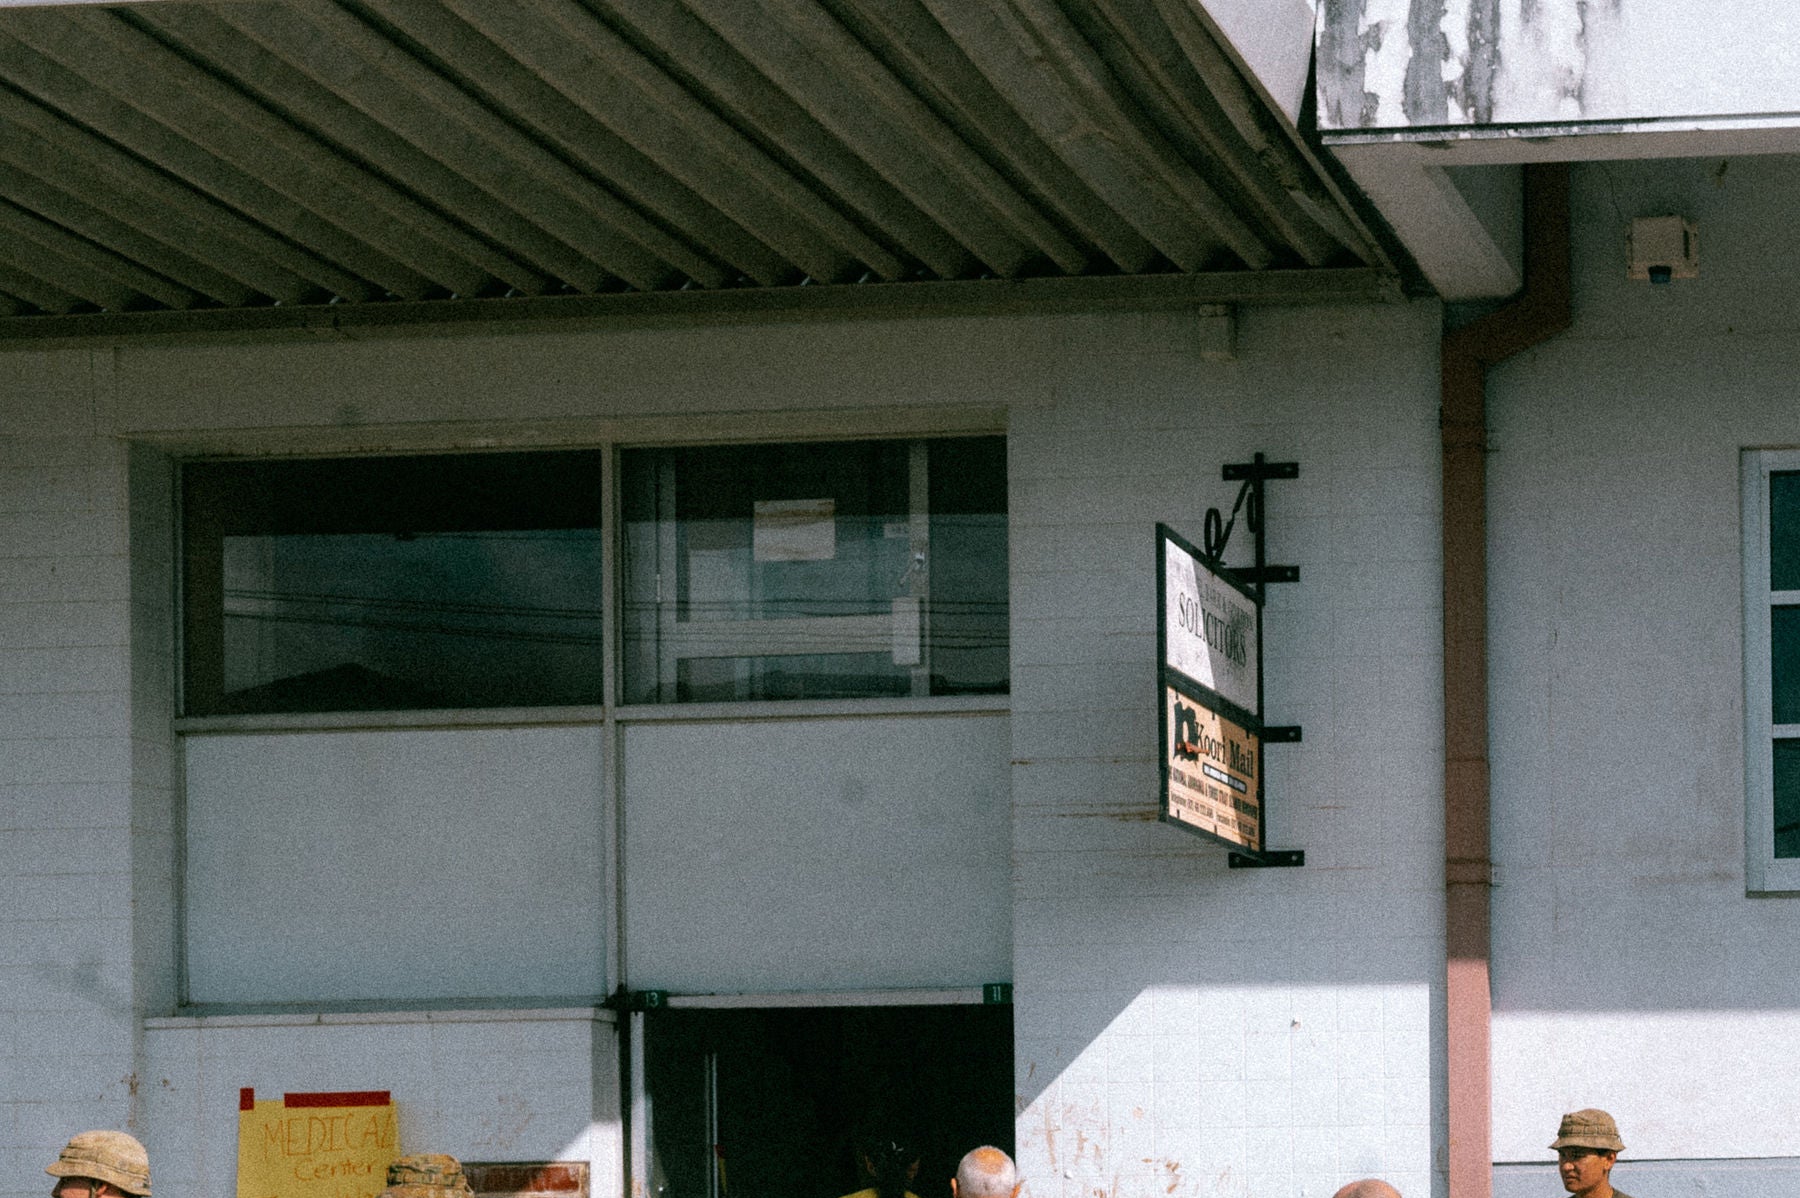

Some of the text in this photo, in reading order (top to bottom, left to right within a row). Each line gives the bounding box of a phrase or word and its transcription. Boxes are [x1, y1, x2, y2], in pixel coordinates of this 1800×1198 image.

[1178, 591, 1247, 668] SOLICITORS
[1195, 721, 1254, 778] Koori Mail
[645, 991, 659, 1009] 13
[264, 1112, 395, 1161] MEDICAL
[294, 1157, 379, 1182] Center
